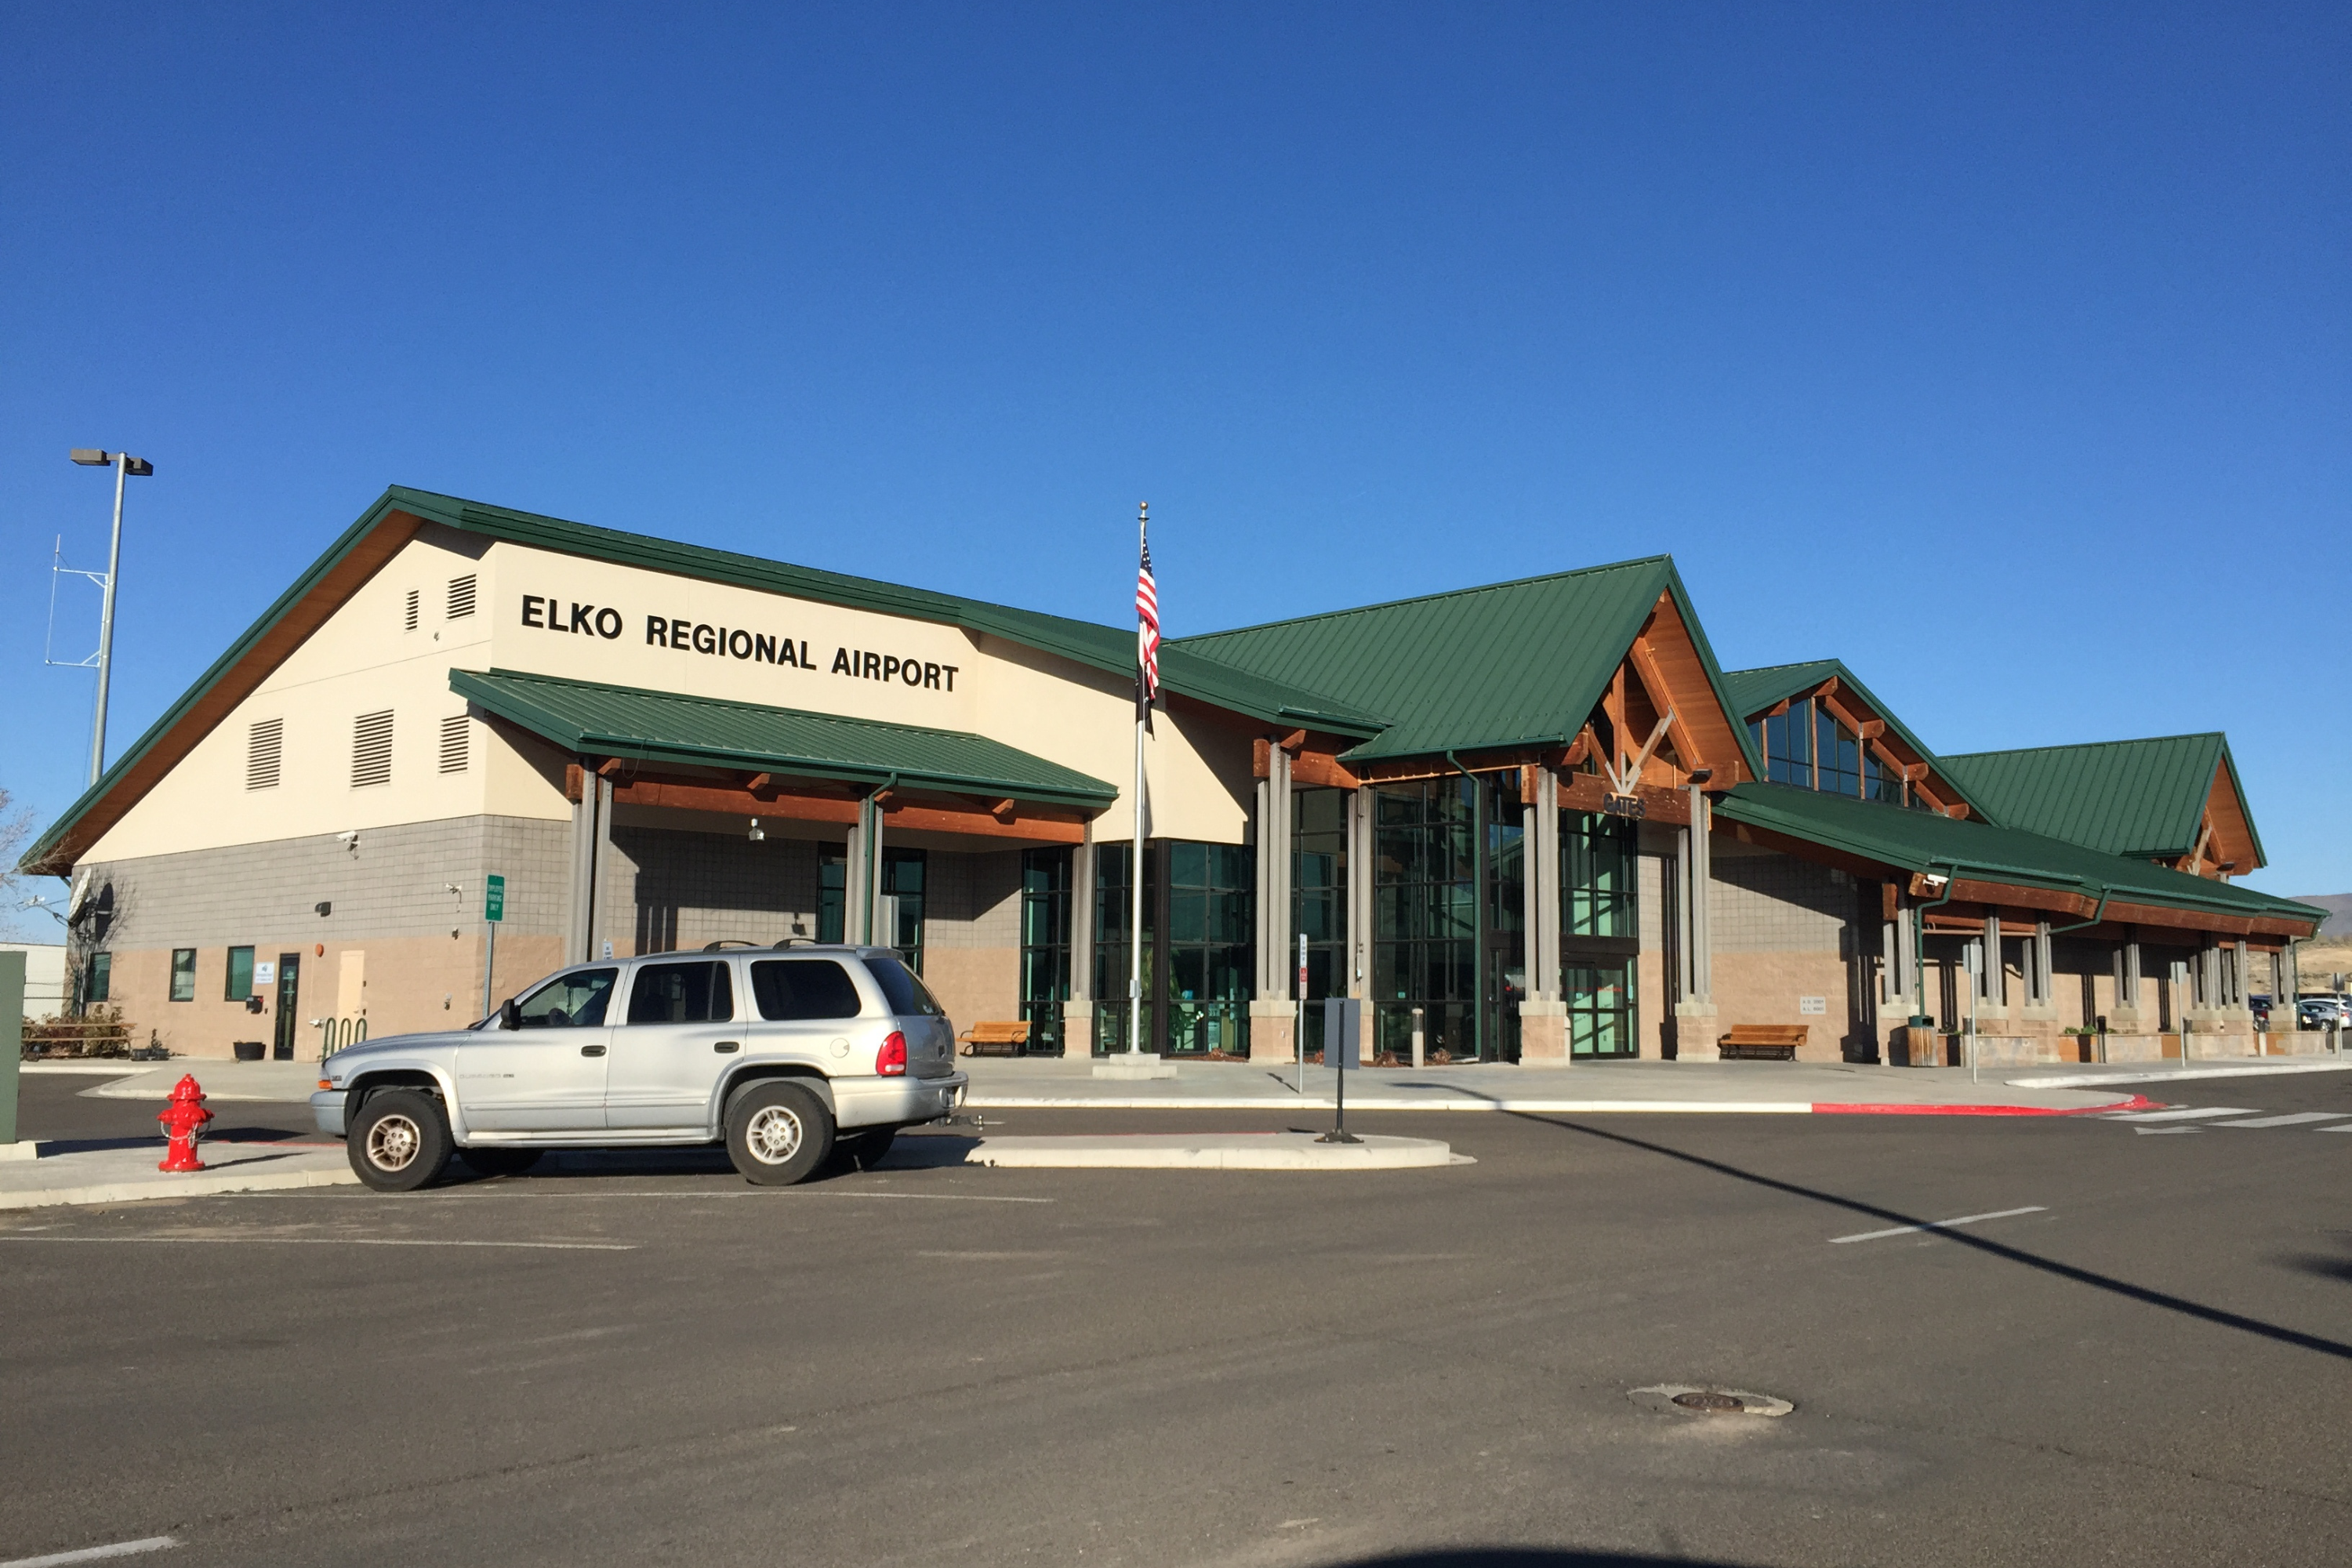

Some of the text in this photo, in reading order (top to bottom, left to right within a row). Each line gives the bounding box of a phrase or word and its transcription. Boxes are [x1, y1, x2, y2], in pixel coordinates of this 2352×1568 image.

[521, 594, 960, 692] ELKO REGIONAL AIRPORT
[1603, 793, 1646, 817] GATES
